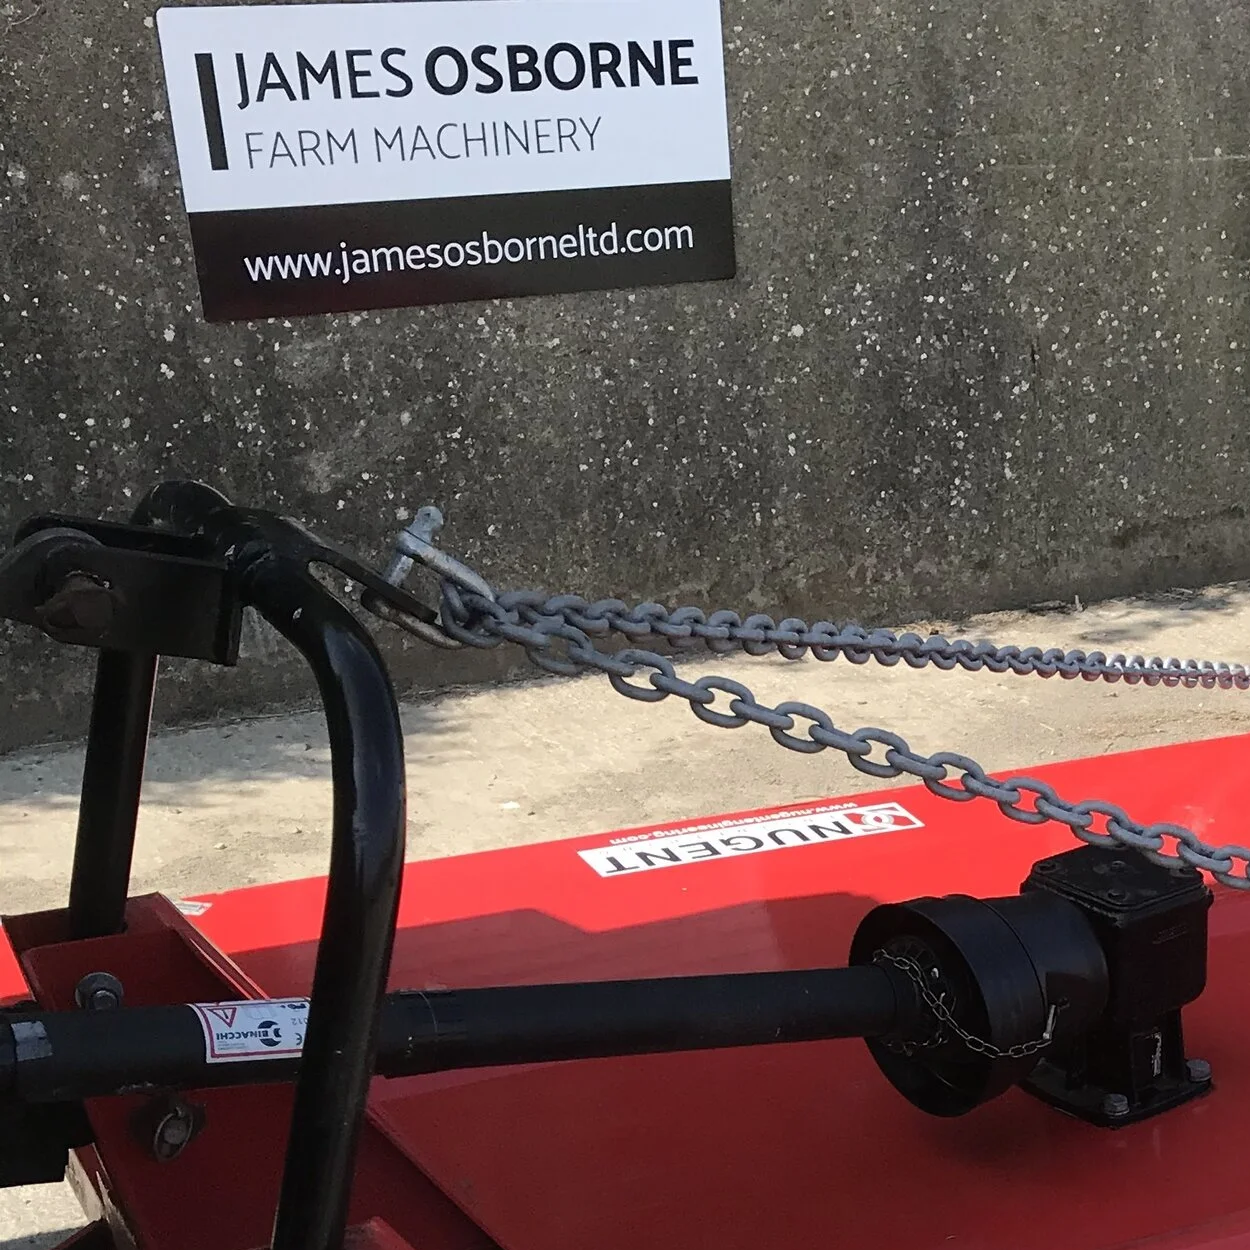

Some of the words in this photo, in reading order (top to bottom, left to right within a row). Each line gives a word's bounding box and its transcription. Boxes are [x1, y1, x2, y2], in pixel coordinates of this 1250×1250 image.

[237, 48, 413, 109] JAMES
[425, 39, 699, 97] OSBORNE
[245, 129, 359, 169] FARM
[374, 116, 602, 162] MACHINERY
[244, 222, 694, 284] www.jamesosborneltd.com
[605, 824, 853, 874] NUGENT
[216, 1030, 269, 1041] BINACCHI
